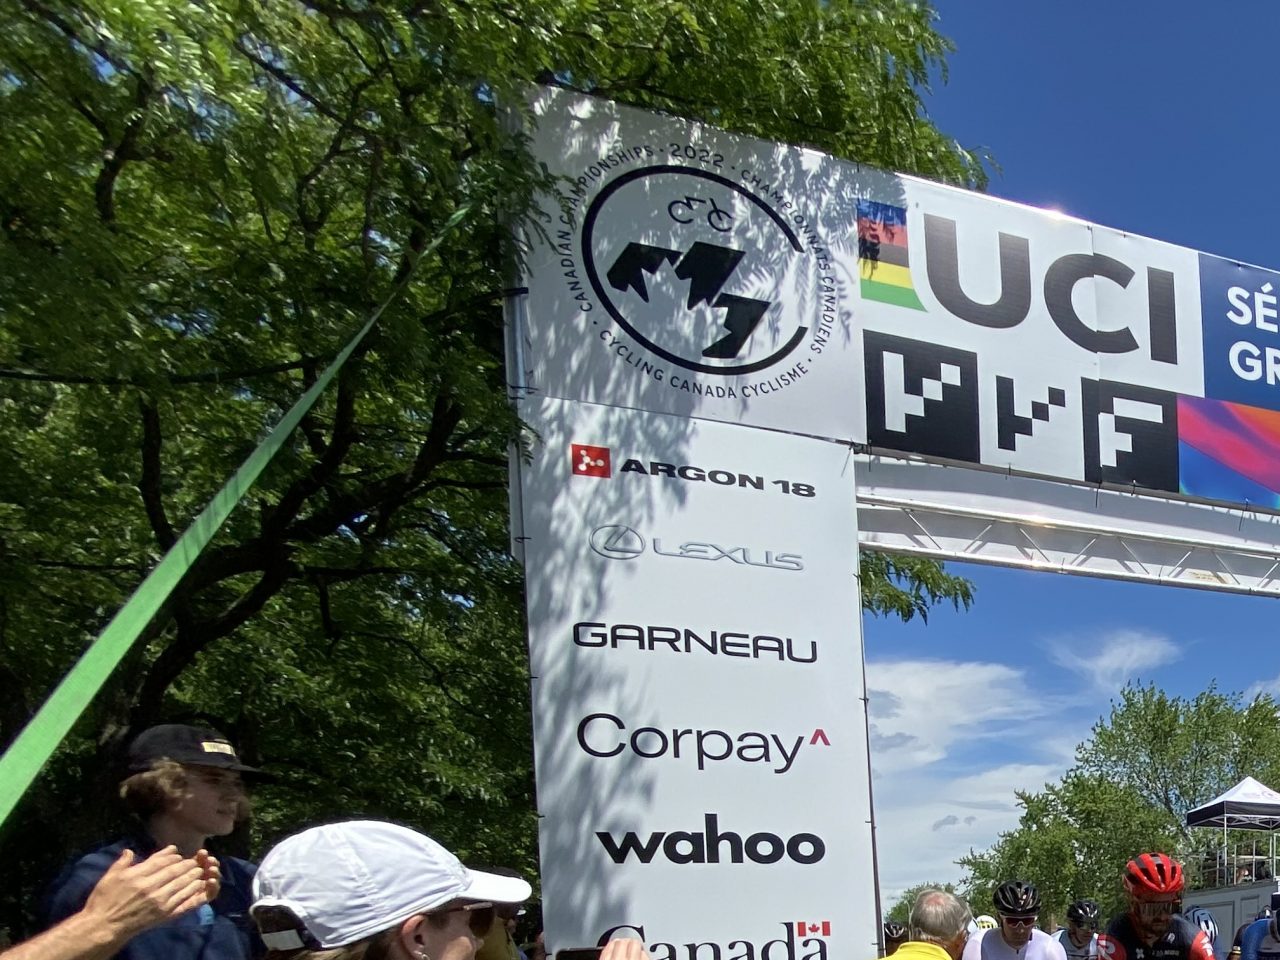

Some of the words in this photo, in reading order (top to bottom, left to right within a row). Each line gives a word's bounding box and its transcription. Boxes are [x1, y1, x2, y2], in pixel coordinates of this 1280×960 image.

[558, 144, 655, 226] CHAMPIONSHIPS
[670, 142, 725, 168] 2022
[559, 230, 593, 312] CANADIAN
[741, 168, 830, 273] CHAMPIONNATS
[809, 275, 837, 354] CANADIENS
[923, 213, 1178, 365] UCI
[600, 328, 664, 382] CYCLING
[669, 374, 737, 399] CANADA
[741, 363, 811, 399] CYCLISME
[620, 458, 764, 490] ARGON
[771, 479, 816, 498] 18
[652, 537, 804, 571] LEXUS
[573, 621, 817, 664] GARNEAU
[595, 813, 826, 865] wahoo
